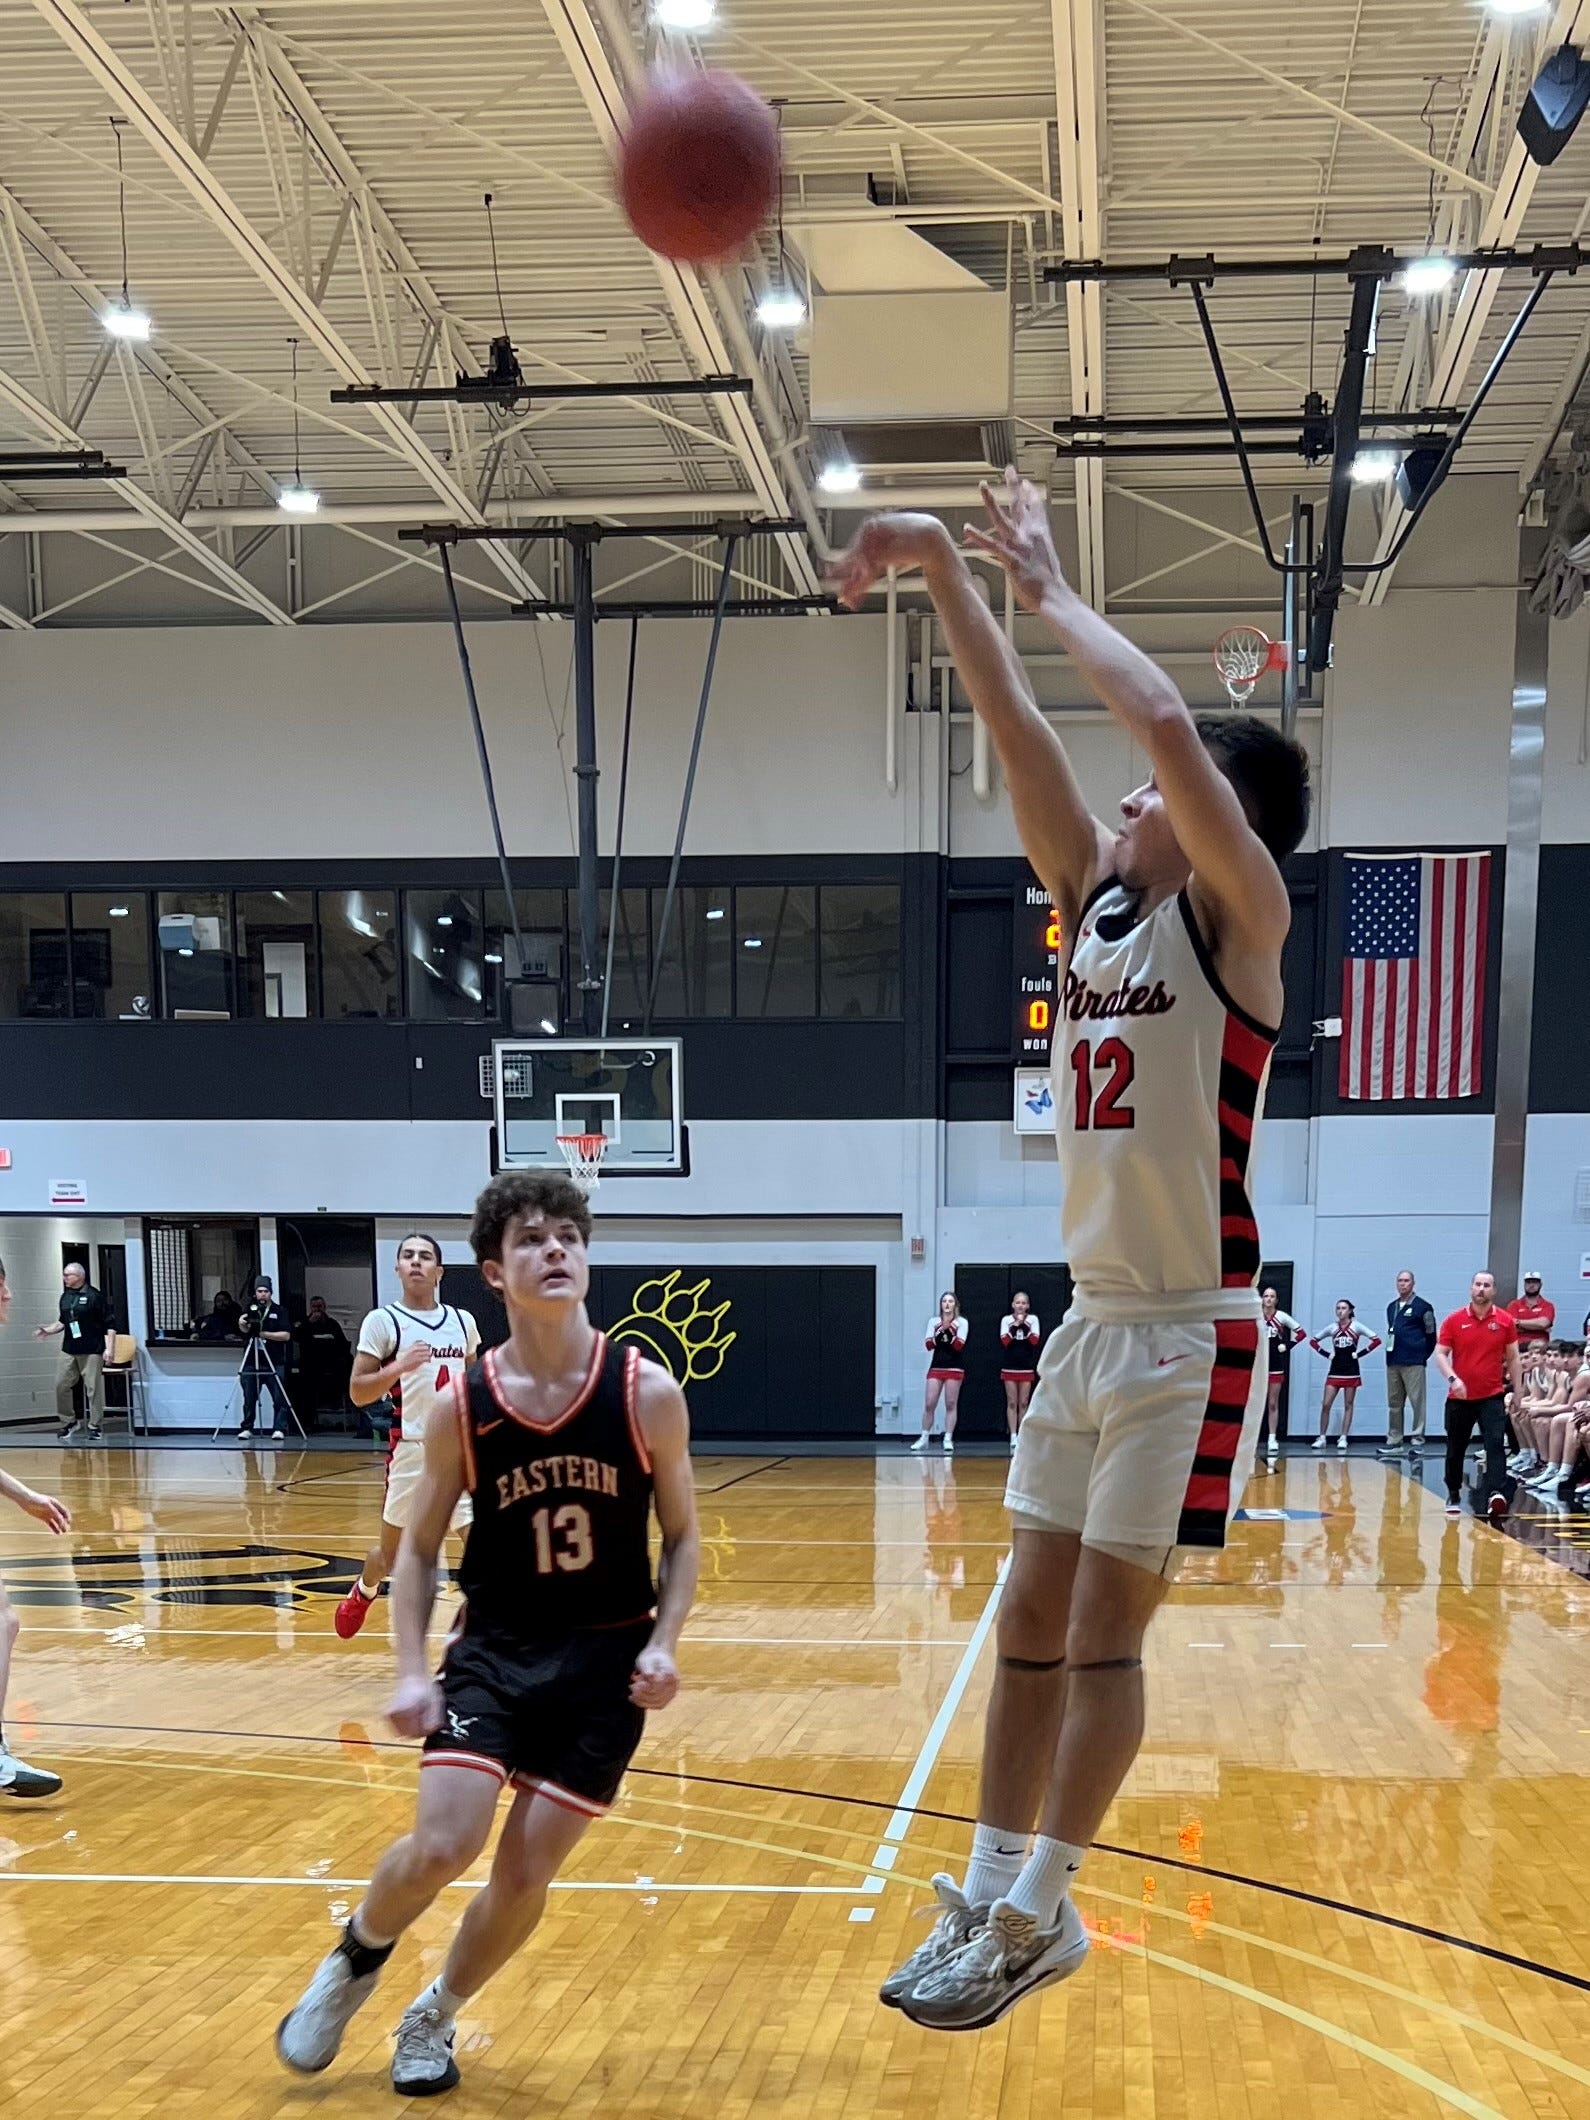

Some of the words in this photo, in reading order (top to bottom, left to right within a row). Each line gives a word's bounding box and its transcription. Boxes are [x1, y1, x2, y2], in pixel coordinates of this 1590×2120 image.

[1029, 1000, 1049, 1030] 0
[1061, 968, 1176, 1023] Pirates
[1023, 1038, 1048, 1050] won
[1070, 1037, 1135, 1131] 12
[430, 1343, 465, 1358] rates
[496, 1455, 620, 1510] EASTERN
[531, 1503, 595, 1574] 13
